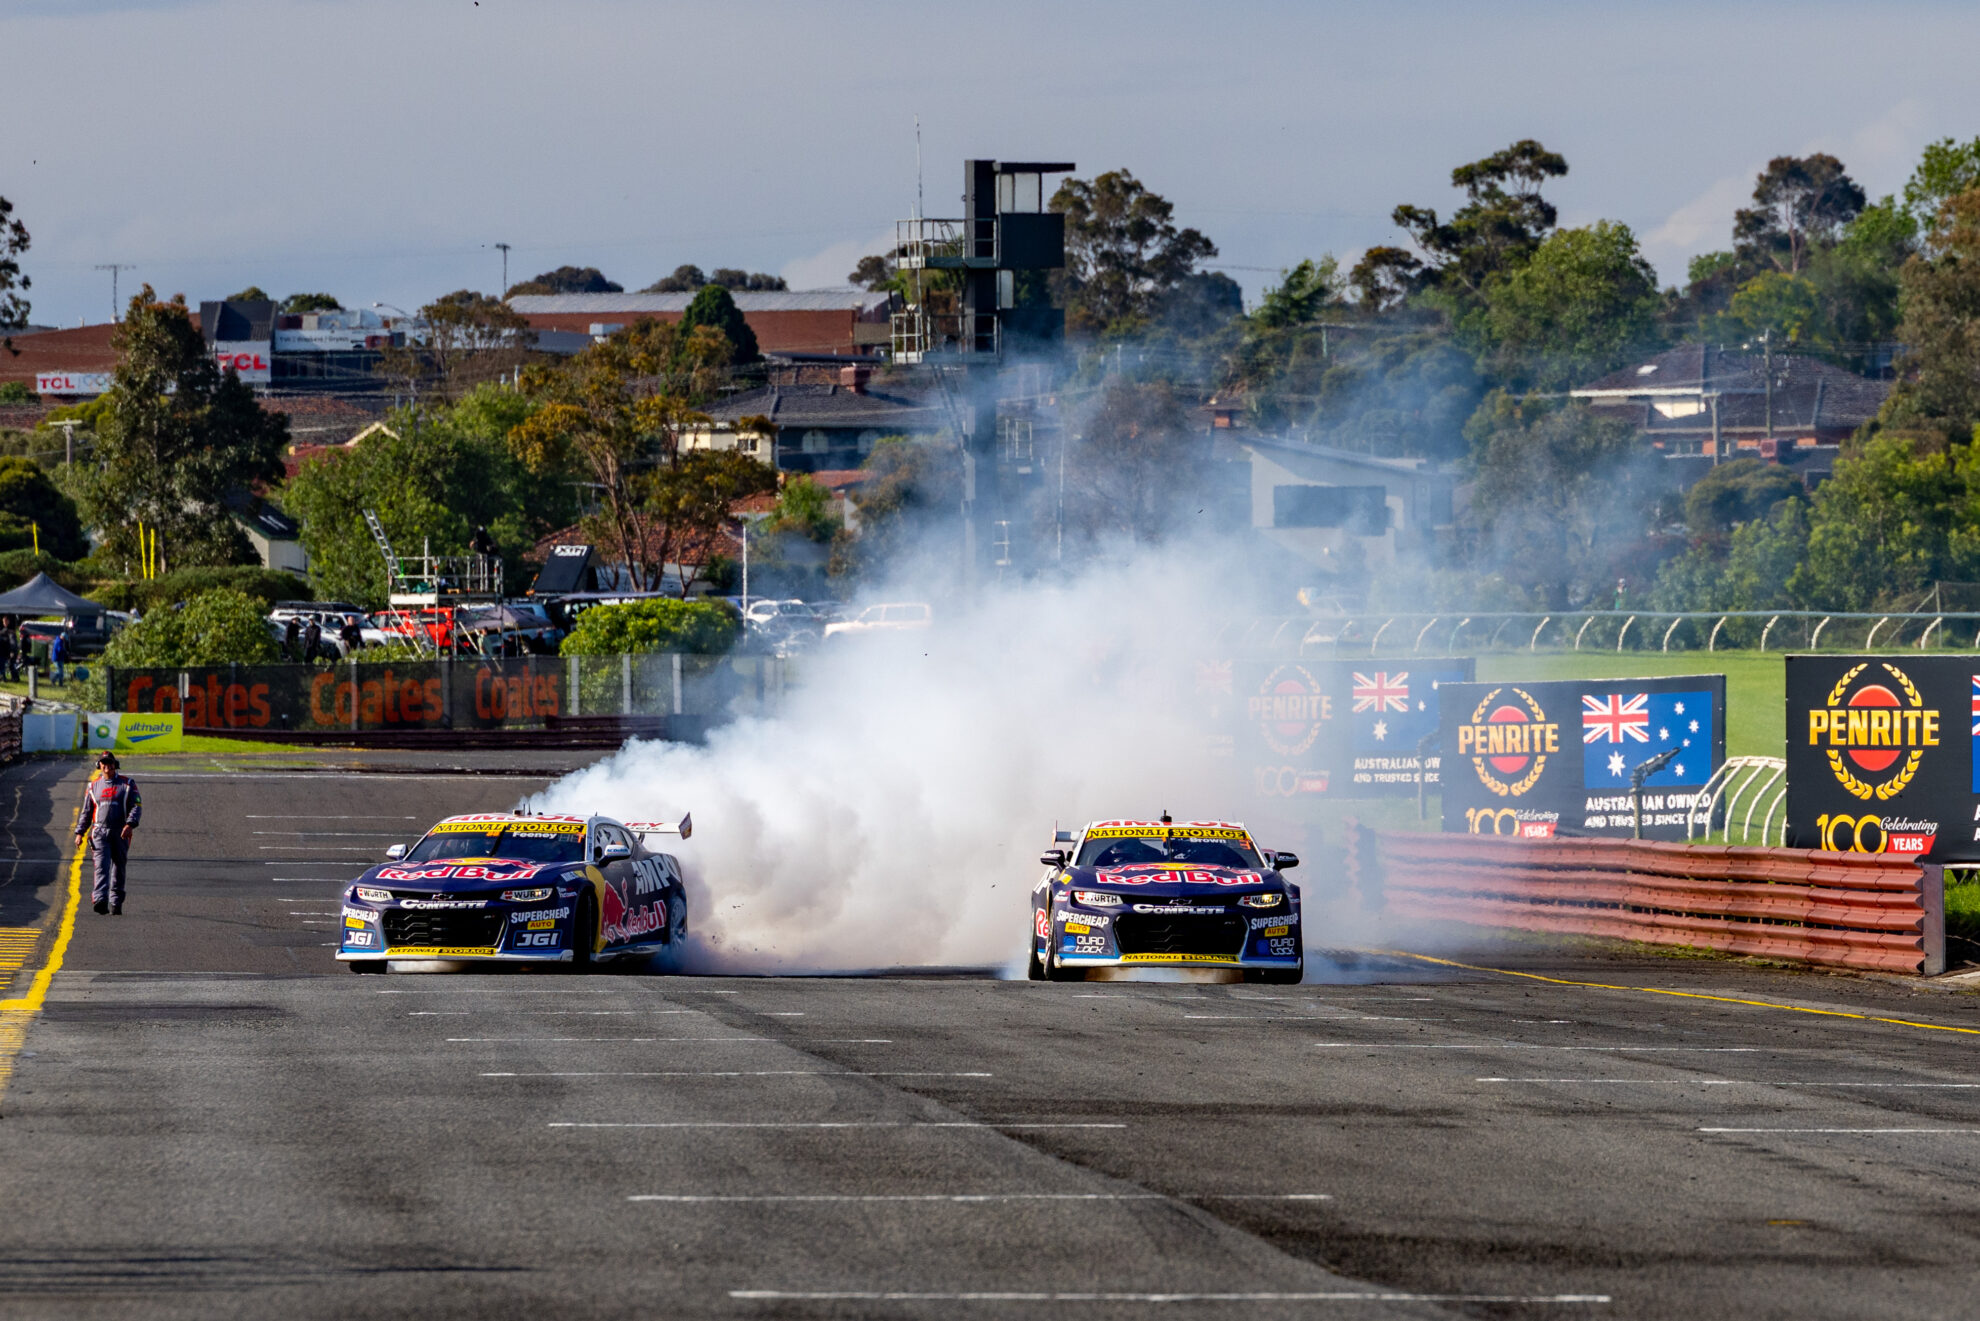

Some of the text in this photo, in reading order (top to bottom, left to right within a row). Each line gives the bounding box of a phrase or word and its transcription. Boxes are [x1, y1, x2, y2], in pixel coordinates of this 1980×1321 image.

[40, 377, 75, 389] TCL
[310, 669, 443, 725] Coates
[475, 665, 559, 720] Coates
[1248, 696, 1332, 720] PENRITE
[125, 722, 173, 732] ultimate
[1809, 709, 1940, 746] PENRITE
[1458, 723, 1560, 754] PENRITE
[1585, 792, 1711, 811] AUSTRAIAN OWND
[436, 823, 581, 834] NATIONAL STORAGE
[1608, 813, 1653, 828] TRUSED
[1879, 816, 1938, 835] Celebrating
[512, 832, 557, 840] Feeney
[1090, 828, 1245, 839] NATIONAL STORAGE
[1816, 814, 1887, 853] 100
[1893, 837, 1923, 851] YEARS
[376, 866, 541, 882] Red Bull
[1096, 870, 1264, 886] Red Bull
[511, 907, 570, 923] SUPERCHEAP
[1056, 910, 1109, 928] SUPERCHEAP
[1067, 924, 1087, 932] AUTO
[1266, 927, 1286, 935] AUTO
[344, 931, 373, 946] JGI
[516, 932, 559, 947] JGI
